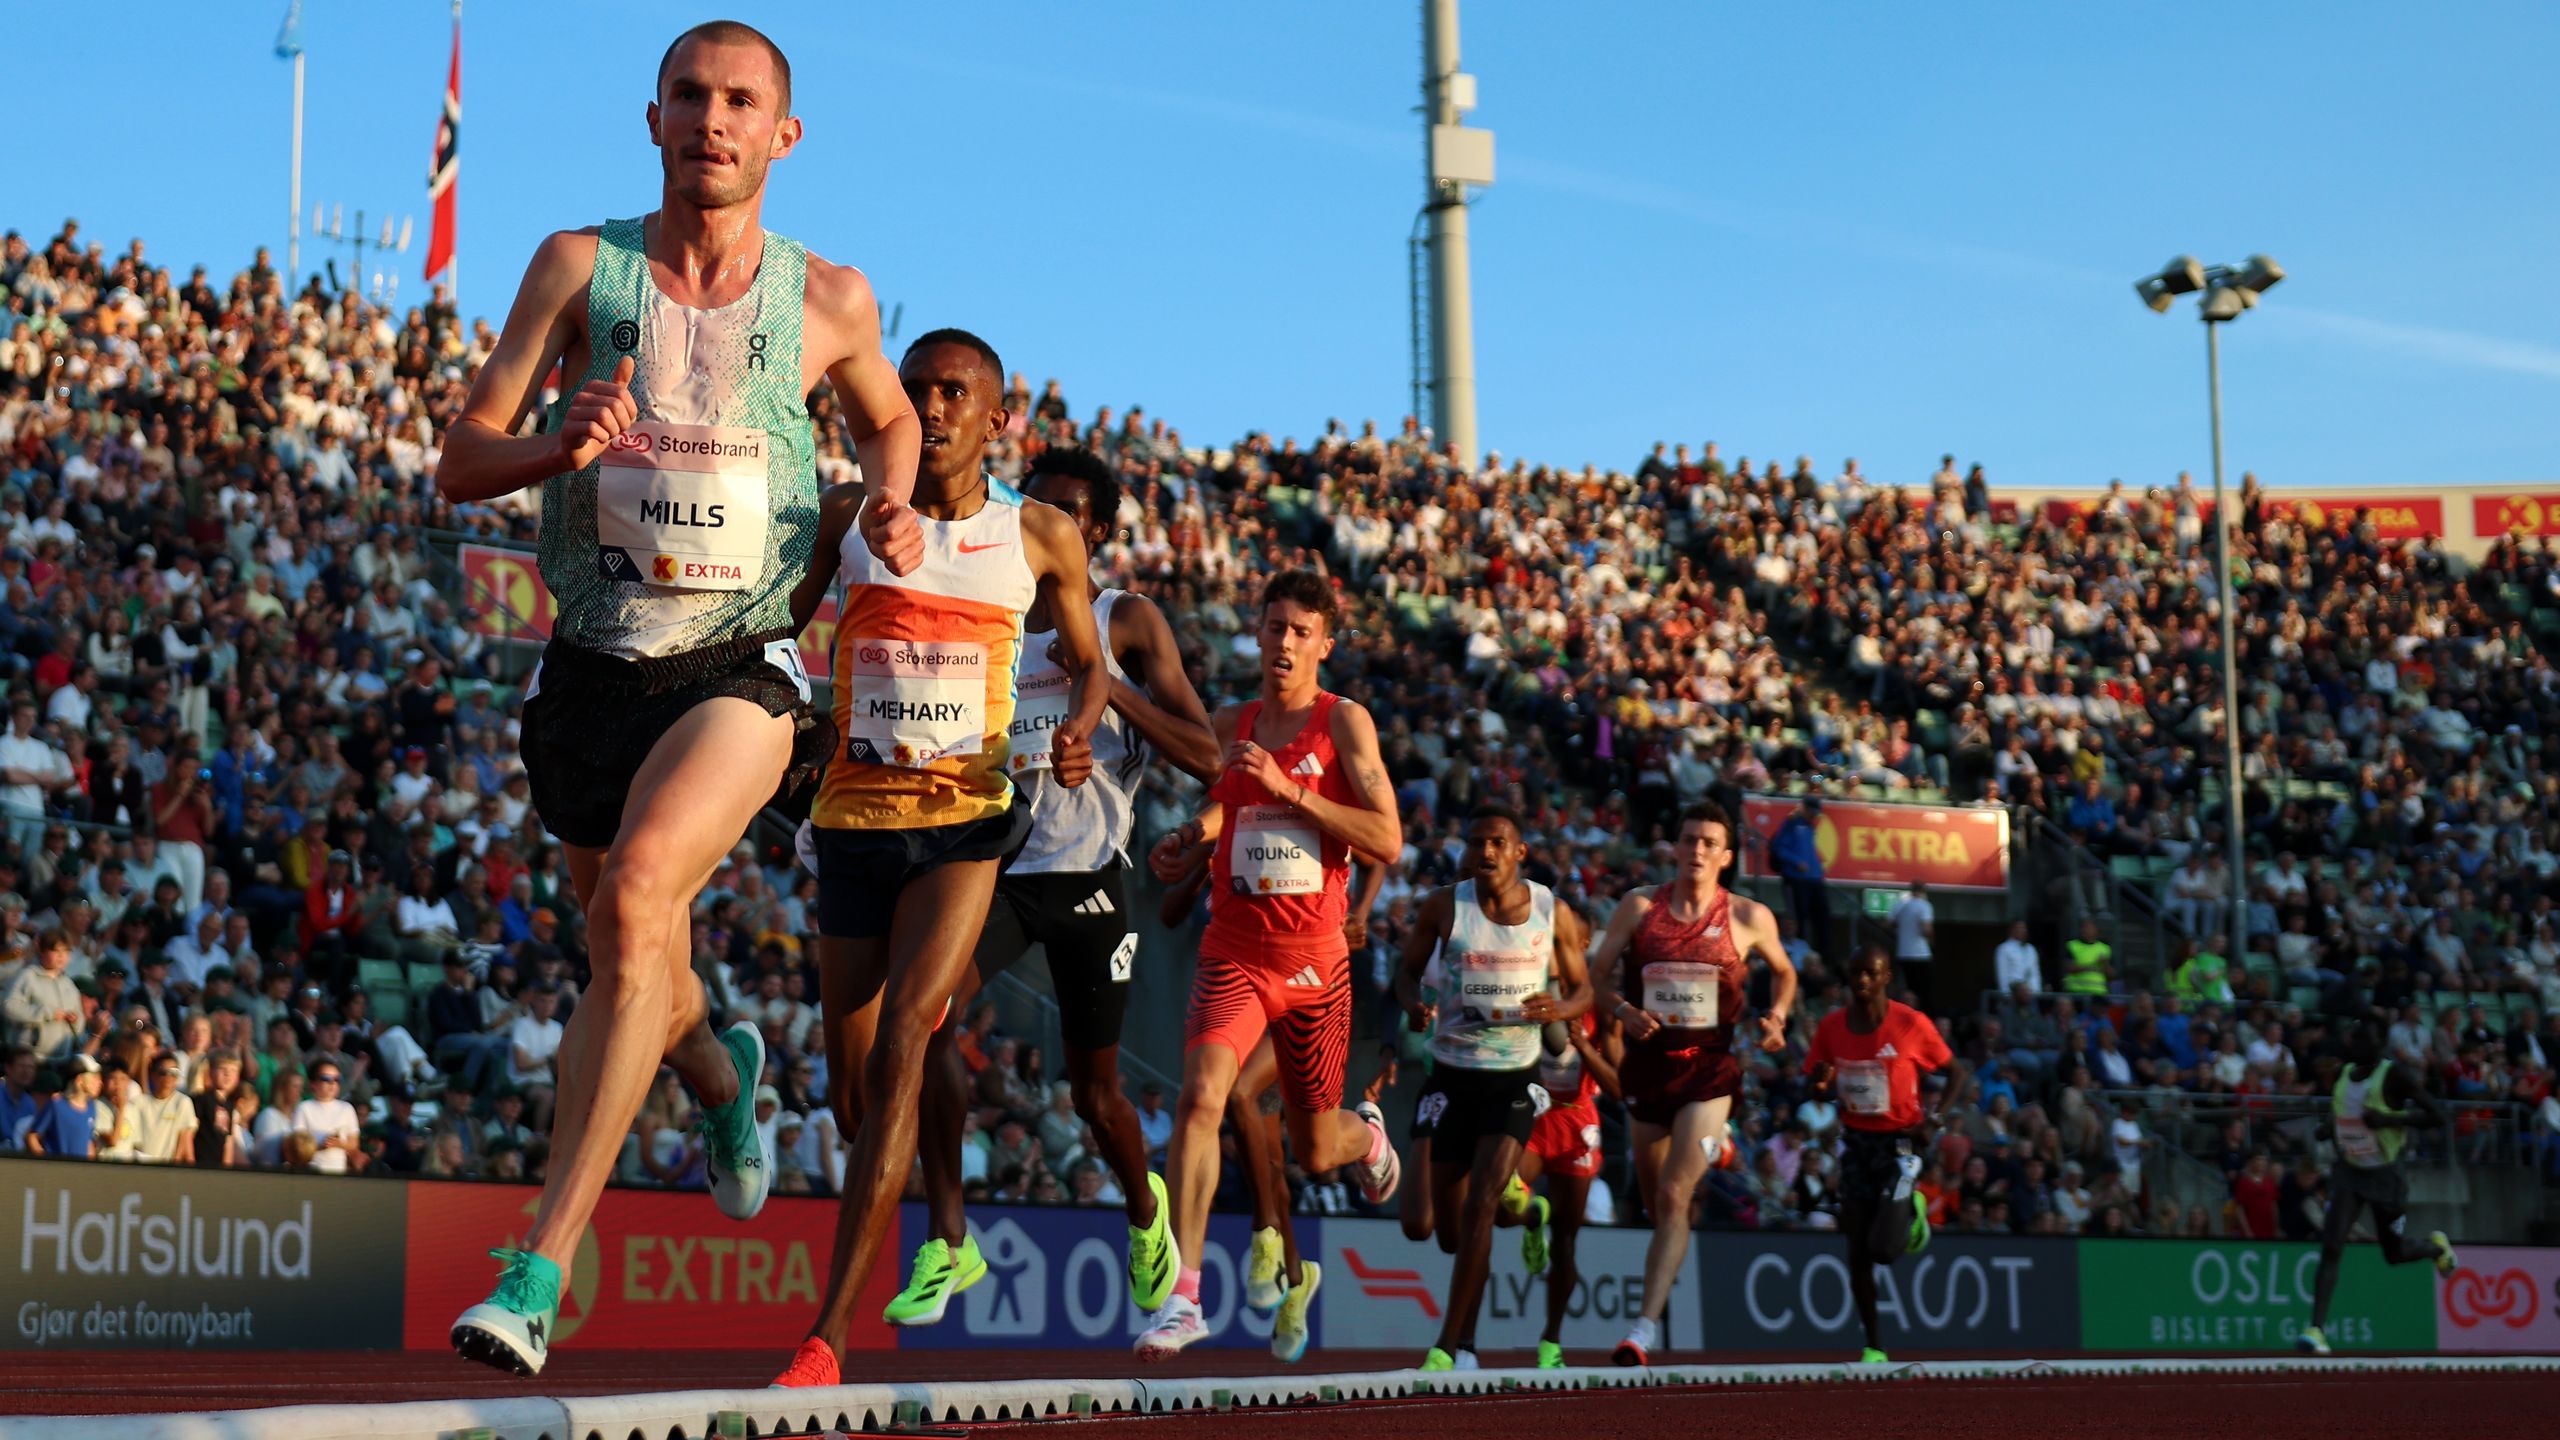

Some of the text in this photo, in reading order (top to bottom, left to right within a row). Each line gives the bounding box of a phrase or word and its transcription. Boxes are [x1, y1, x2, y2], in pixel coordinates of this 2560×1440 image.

[658, 436, 759, 458] Storebrand
[640, 500, 725, 528] MILLS
[685, 563, 742, 580] EXTRA
[895, 651, 979, 666] Storebrand
[869, 700, 964, 722] MEHARY
[1245, 846, 1301, 861] YOUNG
[1849, 826, 1971, 866] EXTRA
[1276, 879, 1310, 888] EXTRA
[1655, 991, 1704, 1003] BLANKS
[20, 1188, 312, 1279] Hafslund
[622, 1236, 819, 1304] EXTRA
[17, 1301, 254, 1346] Gjør det fornybart
[2151, 1315, 2373, 1344] BISLETT GMES
